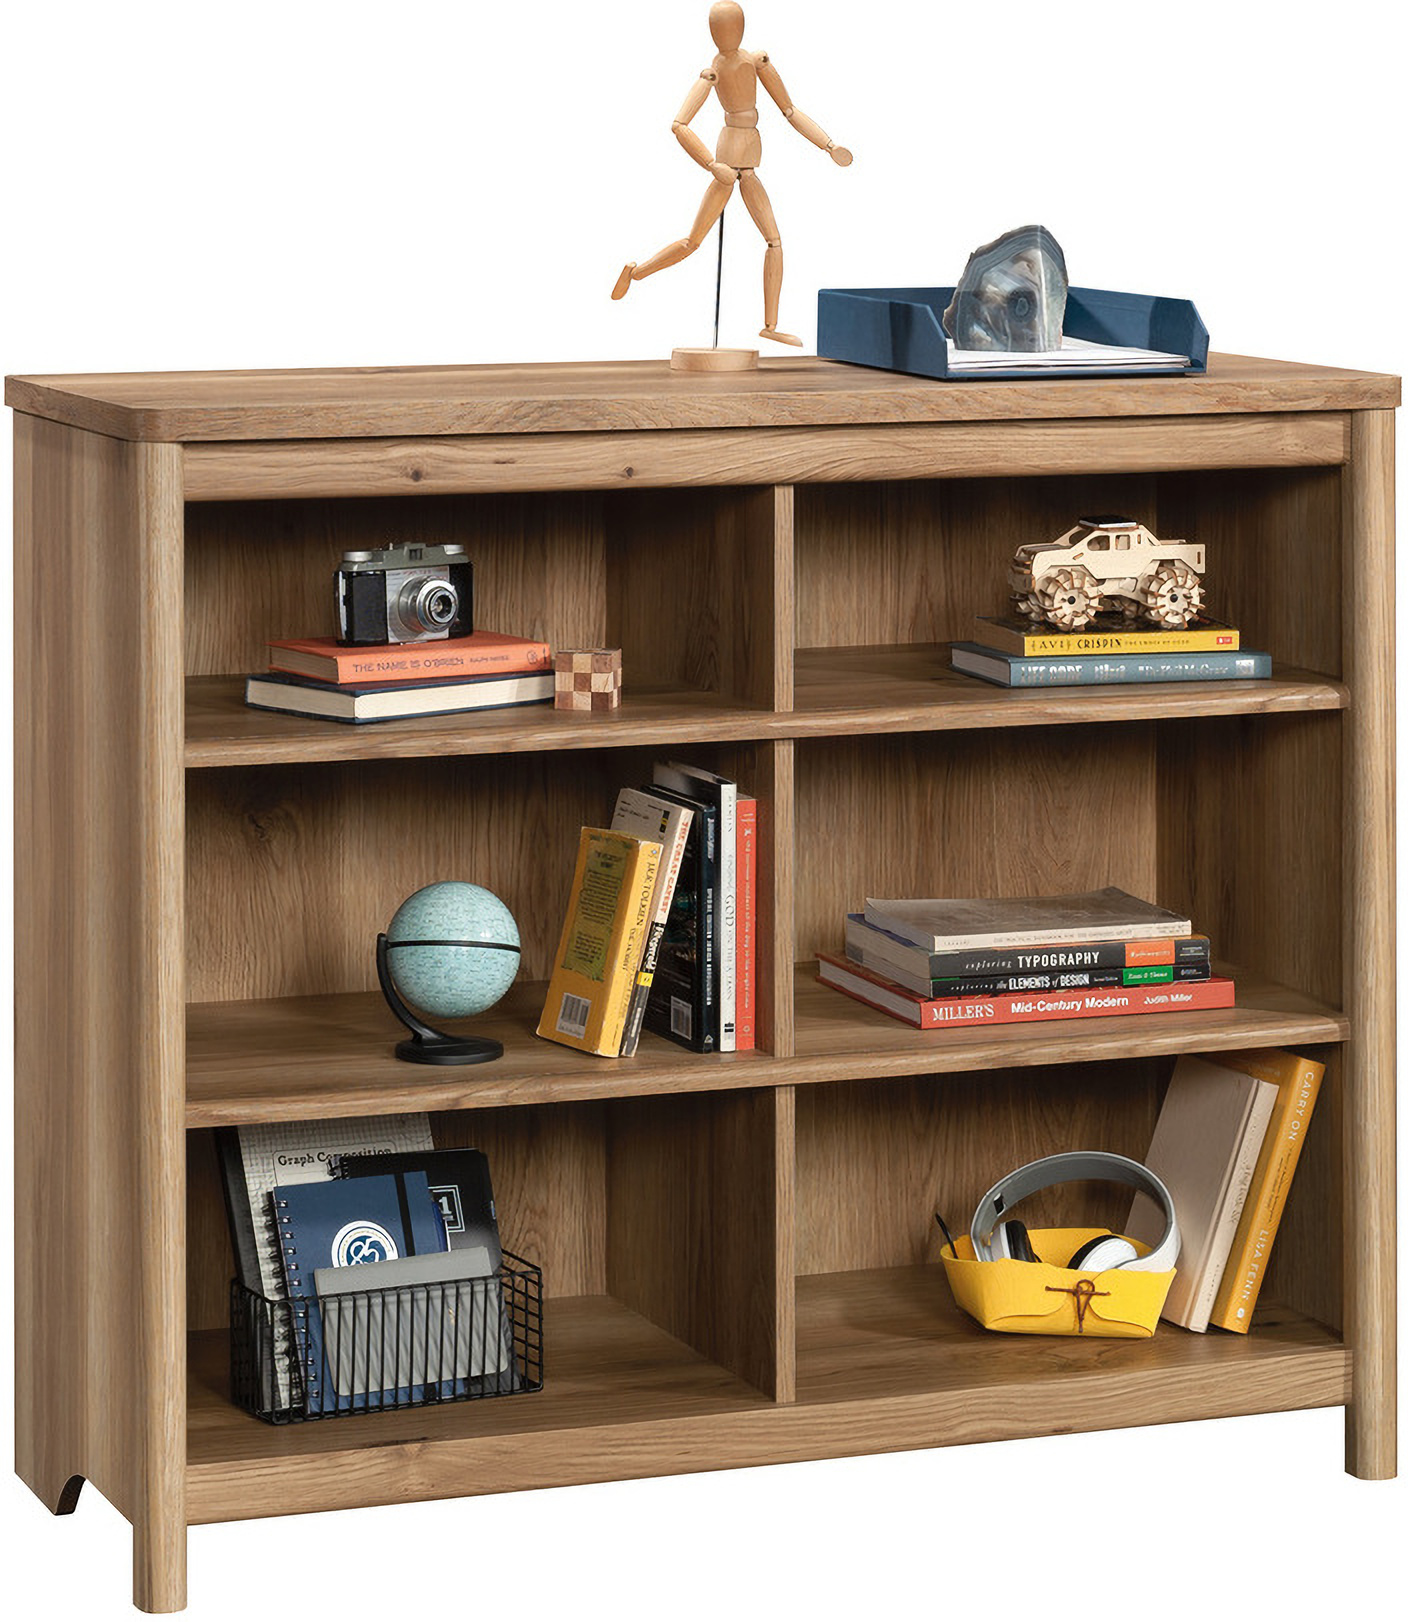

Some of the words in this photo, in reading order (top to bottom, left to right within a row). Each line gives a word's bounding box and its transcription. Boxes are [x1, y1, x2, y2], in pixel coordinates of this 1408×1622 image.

[1077, 638, 1122, 649] CRISPIN
[353, 662, 373, 672] THE
[376, 660, 407, 671] NAME
[678, 820, 689, 841] THE
[670, 842, 683, 873] GREAT
[634, 884, 651, 926] TOLKIEN
[725, 894, 734, 926] GOD
[965, 958, 1012, 972] exploring
[1017, 951, 1100, 969] TYPOGRAPHY
[996, 979, 1008, 990] the
[1009, 976, 1050, 990] ELEMENTS
[1060, 973, 1090, 988] DESIGN
[932, 1004, 995, 1021] MILLER'S
[1011, 999, 1082, 1014] Mid-Century
[1084, 996, 1129, 1009] Modern
[1294, 1071, 1314, 1117] CARRY
[1287, 1119, 1301, 1141] ON
[278, 1153, 315, 1167] Graph
[1252, 1228, 1269, 1259] LISA
[1240, 1262, 1259, 1301] FENN
